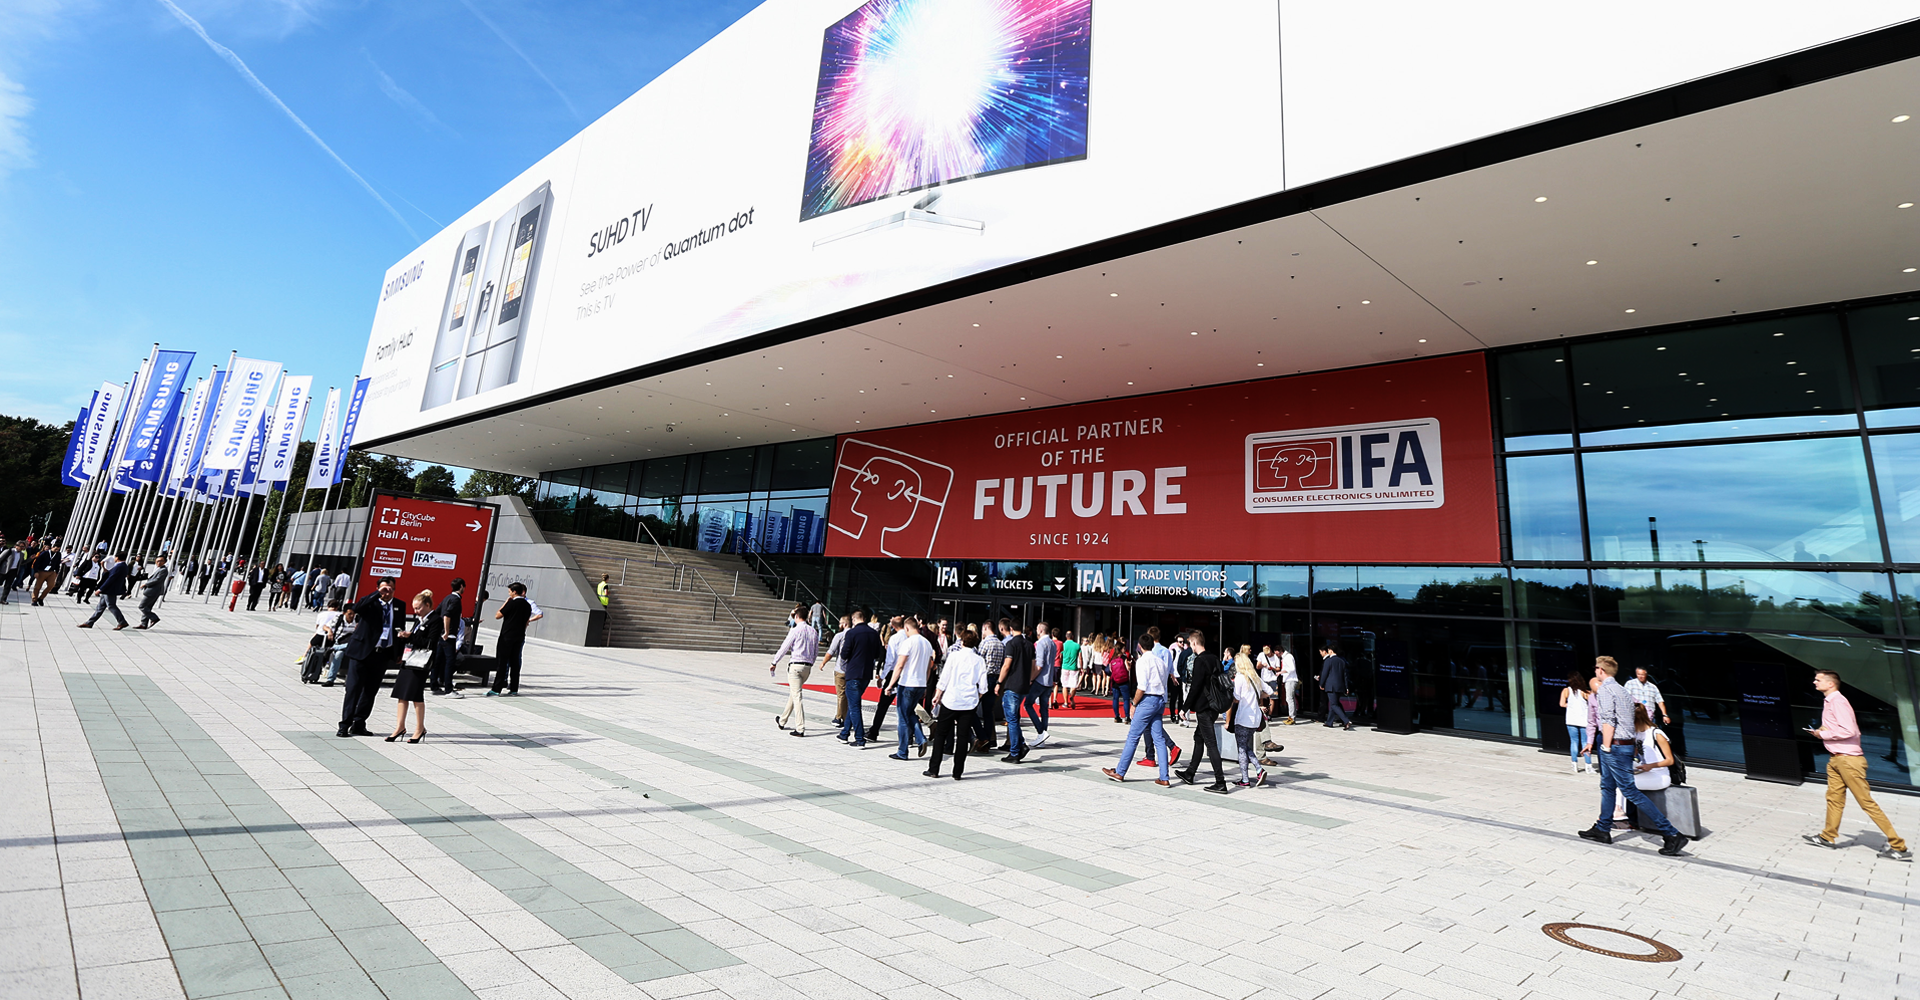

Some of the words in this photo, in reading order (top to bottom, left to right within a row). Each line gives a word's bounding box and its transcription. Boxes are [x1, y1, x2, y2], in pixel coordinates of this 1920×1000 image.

[588, 217, 629, 258] SUHD
[631, 203, 654, 237] TV
[579, 280, 597, 298] See
[598, 272, 614, 290] the
[615, 257, 648, 283] Power
[649, 247, 663, 268] of
[663, 222, 725, 261] Quantum
[728, 205, 755, 234] dot
[383, 259, 425, 302] SAMSUNG
[576, 302, 592, 321] This
[604, 293, 616, 310] TV
[137, 361, 180, 449] SAMSUNG
[224, 371, 264, 458] SAMSUNG
[273, 387, 302, 469] SAMSUNG
[994, 426, 1069, 449] OFFICIAL
[1076, 417, 1164, 441] PARTNER
[1041, 451, 1064, 467] OF
[1070, 447, 1105, 465] THE
[1341, 430, 1434, 490] IFA
[973, 465, 1188, 520] FUTURE
[1252, 495, 1304, 503] CONSUMER
[1306, 492, 1373, 502] ELECTRONICS
[1374, 490, 1435, 499] UNLIMITED
[400, 519, 423, 528] Berlin
[401, 511, 436, 522] CityCube
[377, 529, 399, 539] Hall
[400, 531, 409, 541] A
[1029, 533, 1069, 546] SINCE
[1075, 532, 1110, 546] 1924
[936, 566, 959, 588] IFA
[995, 579, 1034, 590] TICKETS
[1076, 569, 1106, 593] IFA
[1134, 569, 1171, 581] TRADE
[1173, 570, 1228, 582] VISITORS
[1133, 585, 1188, 596] EXHIBITORS
[1196, 587, 1227, 597] PRESS
